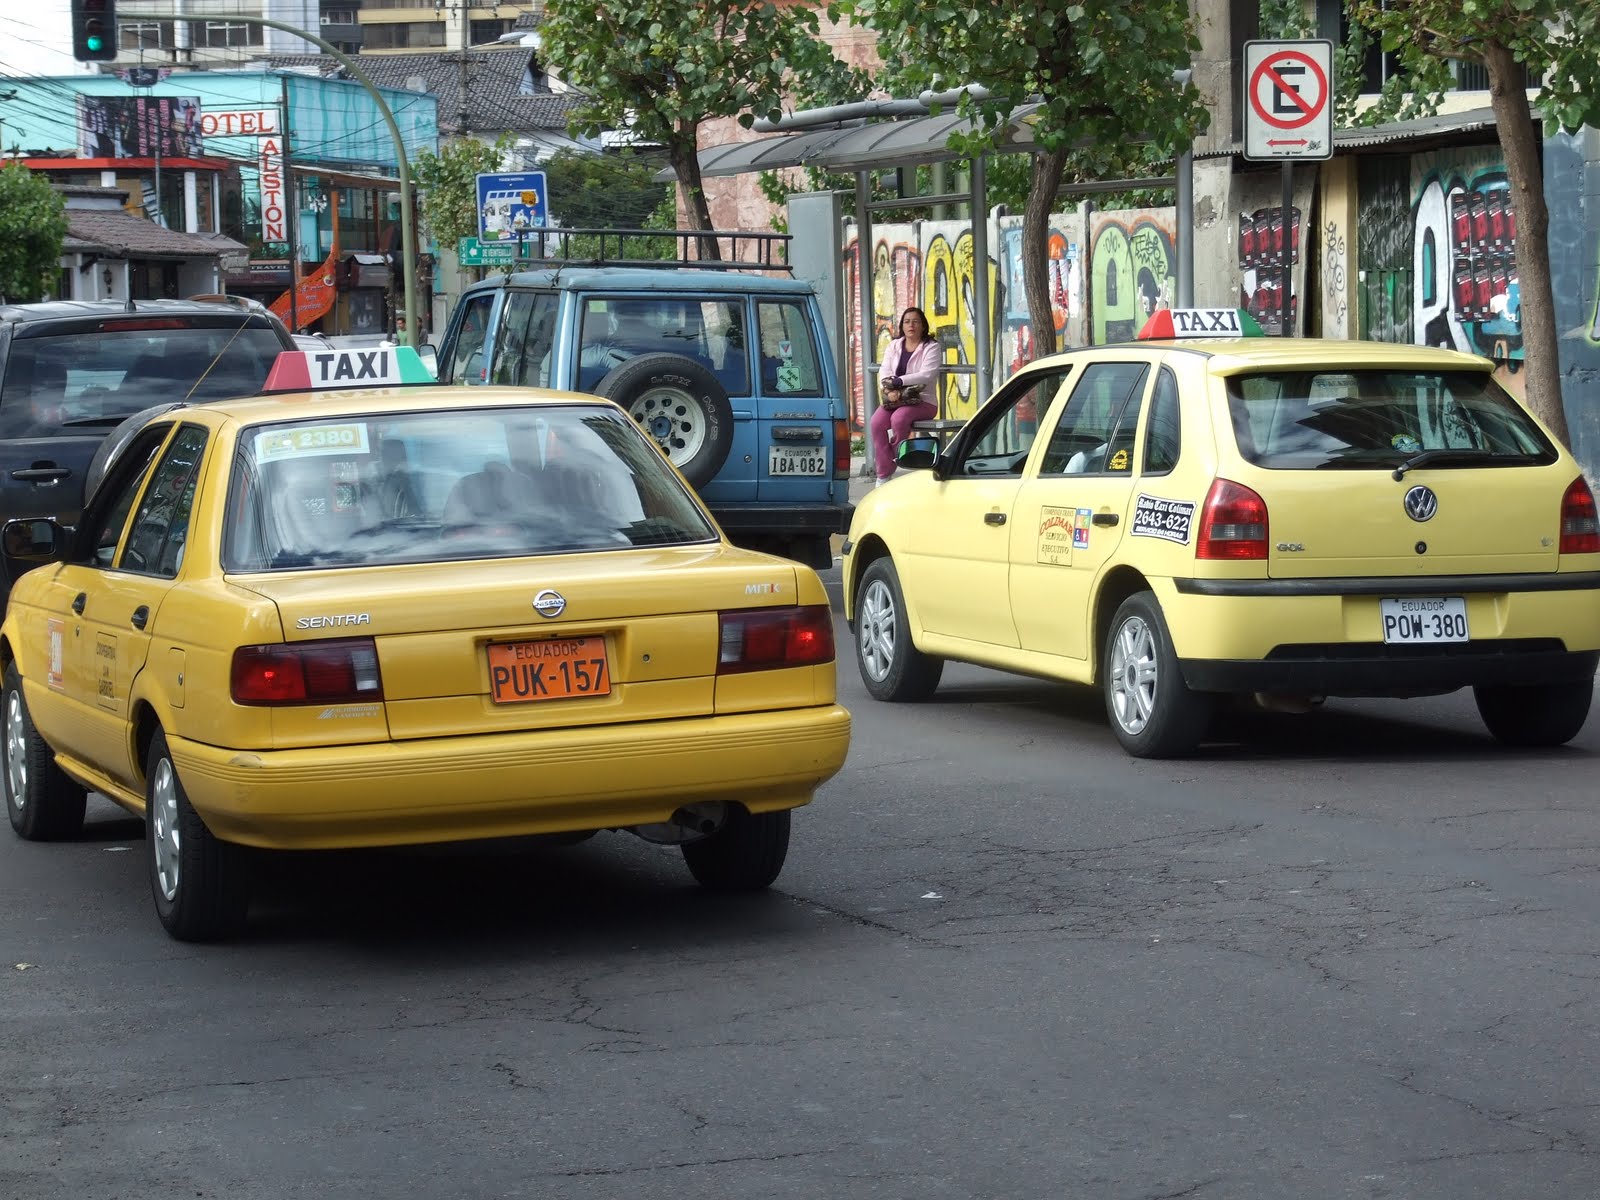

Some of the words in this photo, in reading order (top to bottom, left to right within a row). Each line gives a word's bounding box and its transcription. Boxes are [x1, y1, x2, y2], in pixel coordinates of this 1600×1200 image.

[201, 111, 275, 135] OTEL
[262, 139, 284, 240] ALSTON
[1172, 311, 1240, 332] TAXI
[315, 351, 389, 381] TAXI
[779, 374, 795, 390] BORDO
[299, 429, 354, 447] 2380
[784, 449, 812, 457] ECUADOR
[771, 457, 825, 473] IBA-082
[1039, 516, 1074, 539] COLIMAR
[1134, 509, 1189, 532] 2643-622
[1276, 543, 1305, 552] GOL
[1401, 601, 1446, 612] ECUADOR
[296, 613, 371, 630] SENTRA
[1384, 614, 1467, 640] POW-380
[514, 643, 579, 661] ECUADOR
[492, 658, 606, 699] PUK-157
